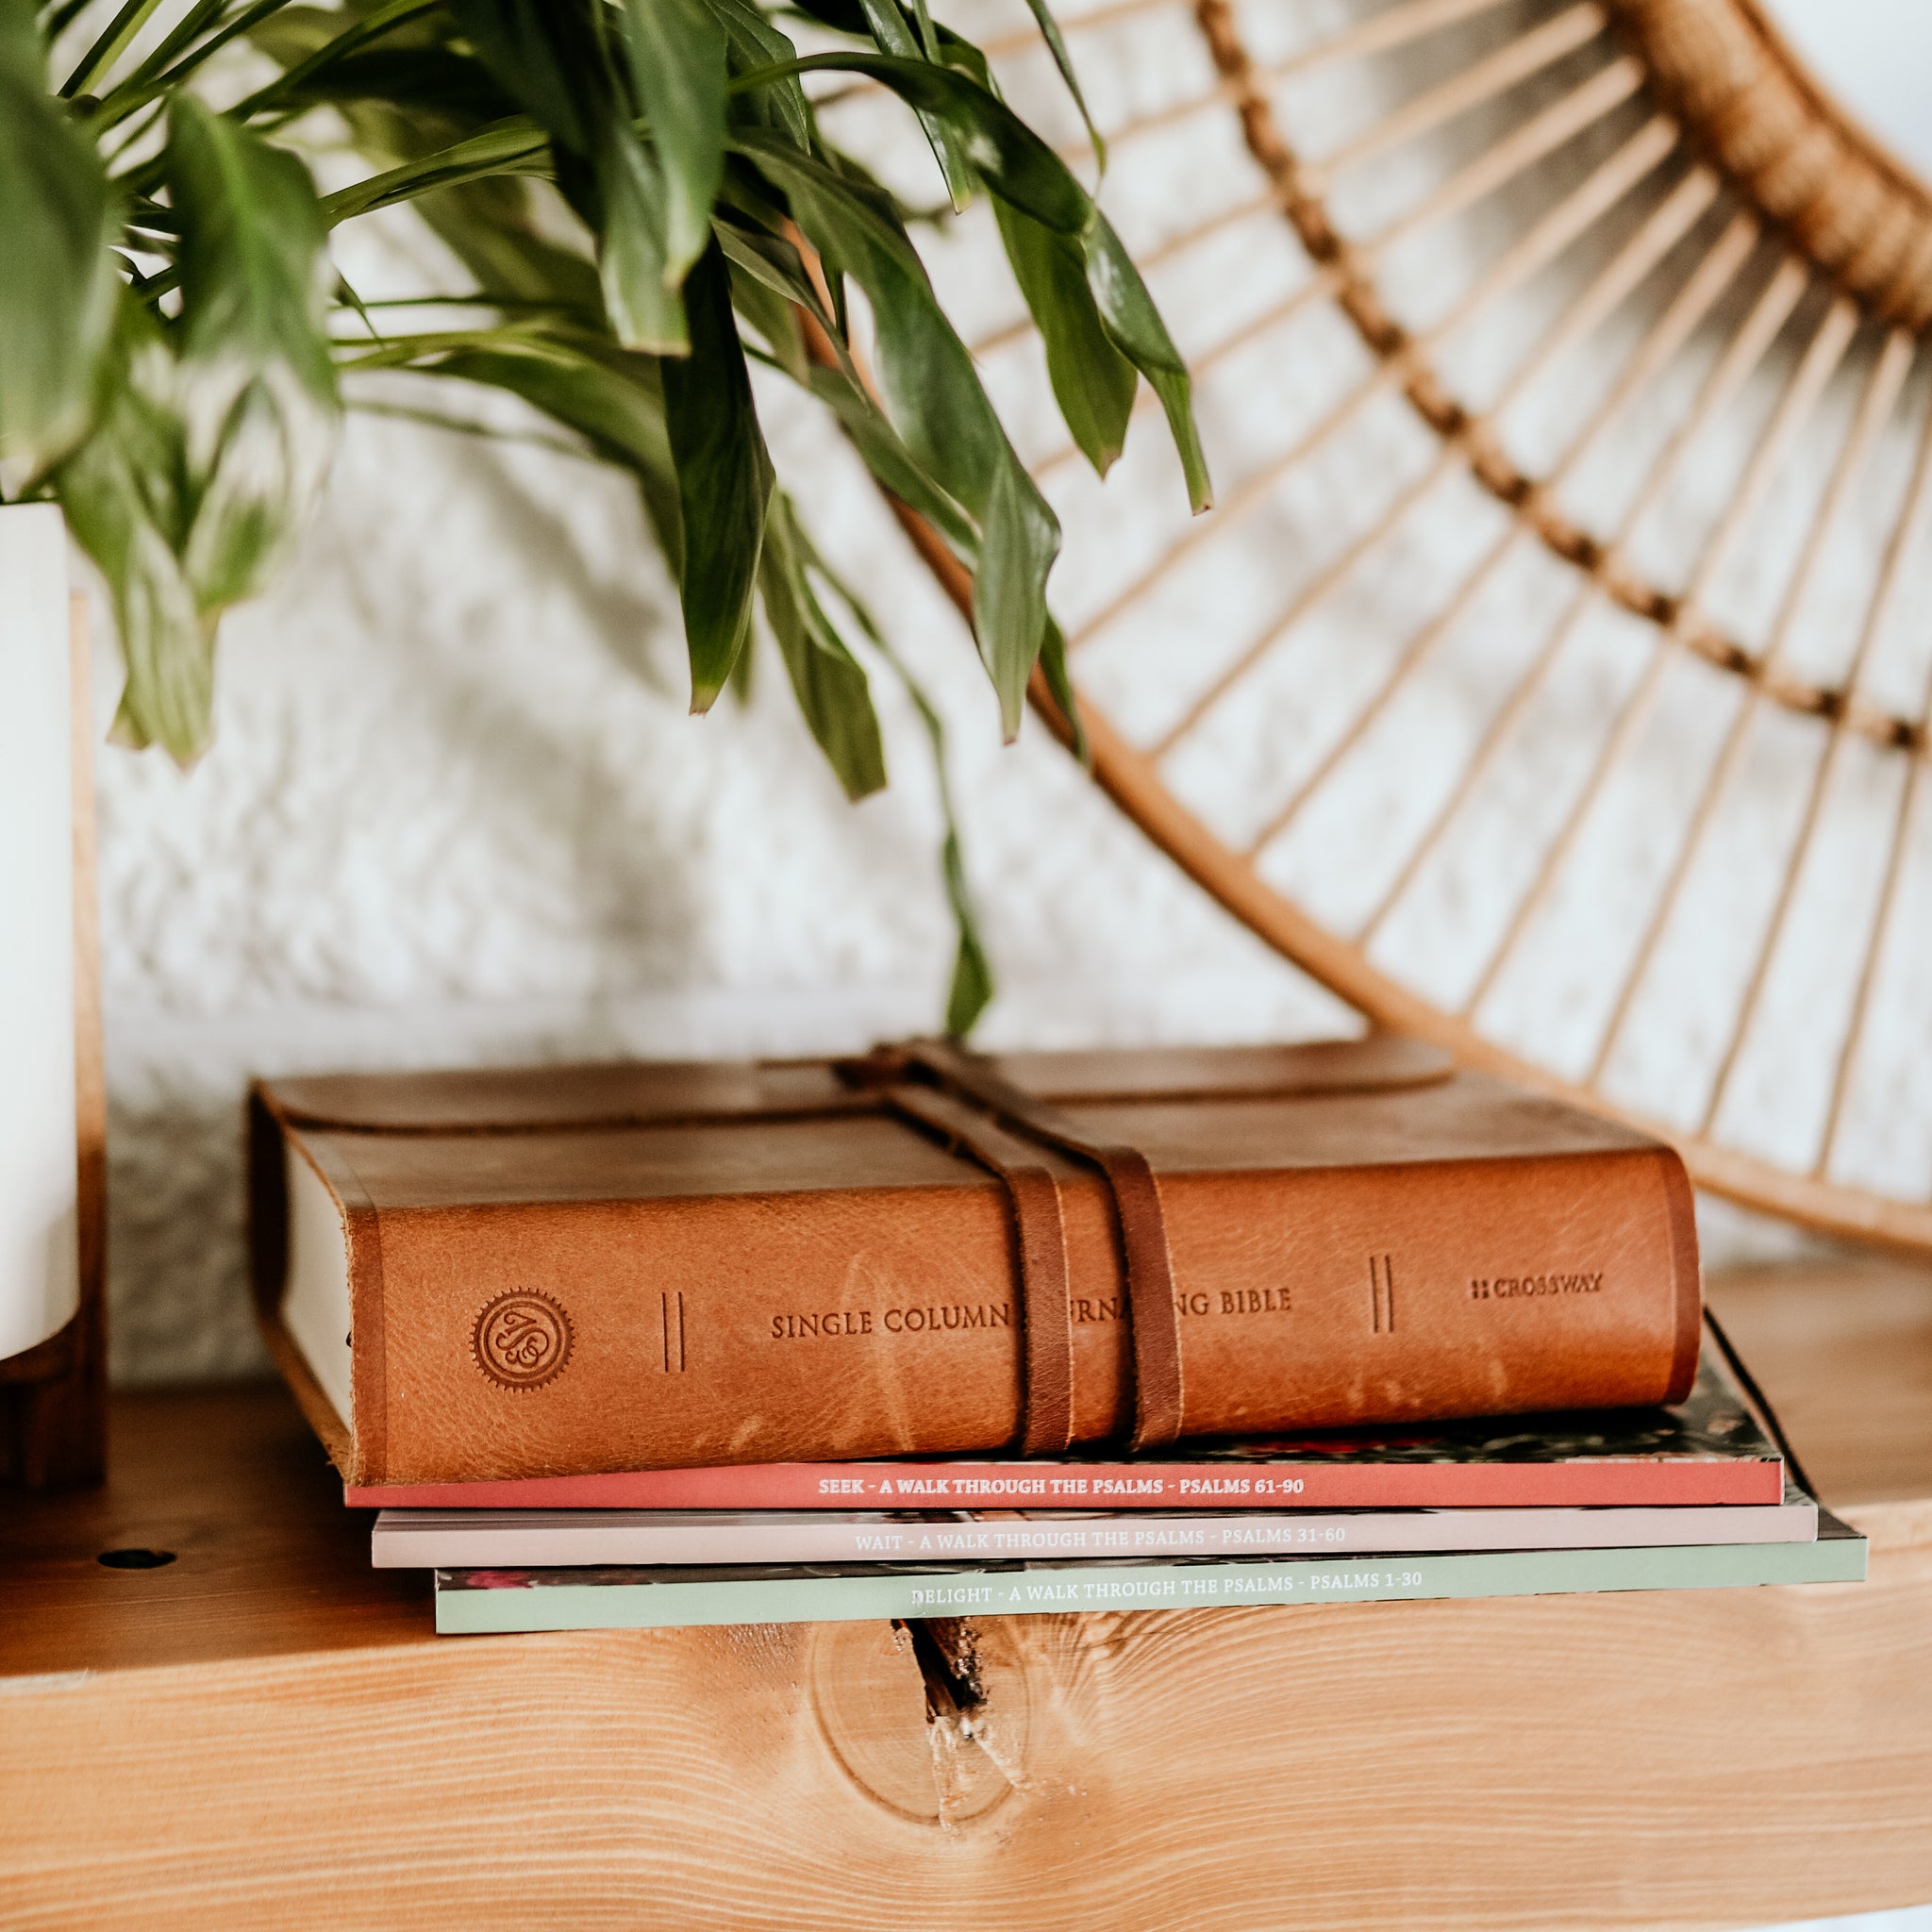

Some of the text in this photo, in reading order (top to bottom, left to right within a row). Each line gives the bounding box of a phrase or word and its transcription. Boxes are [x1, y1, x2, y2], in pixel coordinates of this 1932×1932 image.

[1493, 1273, 1602, 1298] CROSSWAY
[771, 1311, 873, 1339] SINGLE
[883, 1304, 1010, 1332] COLUMN
[1220, 1288, 1291, 1315] BIBLE
[818, 1479, 865, 1494] SEEK
[878, 1479, 893, 1494] A
[896, 1479, 950, 1494] WALK
[952, 1479, 1046, 1494] THROUGH
[1050, 1479, 1089, 1494] THE
[1092, 1478, 1164, 1494] PSALMS
[1179, 1478, 1251, 1494] PSALMS
[1254, 1478, 1305, 1494] 61-90
[856, 1535, 904, 1551] WAIT
[919, 1535, 932, 1549] A
[936, 1533, 990, 1549] WALK
[993, 1532, 1087, 1548] THROUGH
[1091, 1530, 1129, 1546] THE
[1134, 1529, 1205, 1546] PSALMS
[1222, 1528, 1292, 1544] PSALMS
[1296, 1526, 1346, 1542] 31-60
[911, 1587, 993, 1605] DELIGHT
[1008, 1586, 1022, 1602] A
[1026, 1584, 1078, 1601] WALK
[1083, 1581, 1176, 1599] THROUGH
[1180, 1578, 1219, 1594] THE
[1224, 1575, 1293, 1593] PSALMS
[1310, 1573, 1379, 1590] PSALMS
[1385, 1571, 1423, 1587] 1-30
